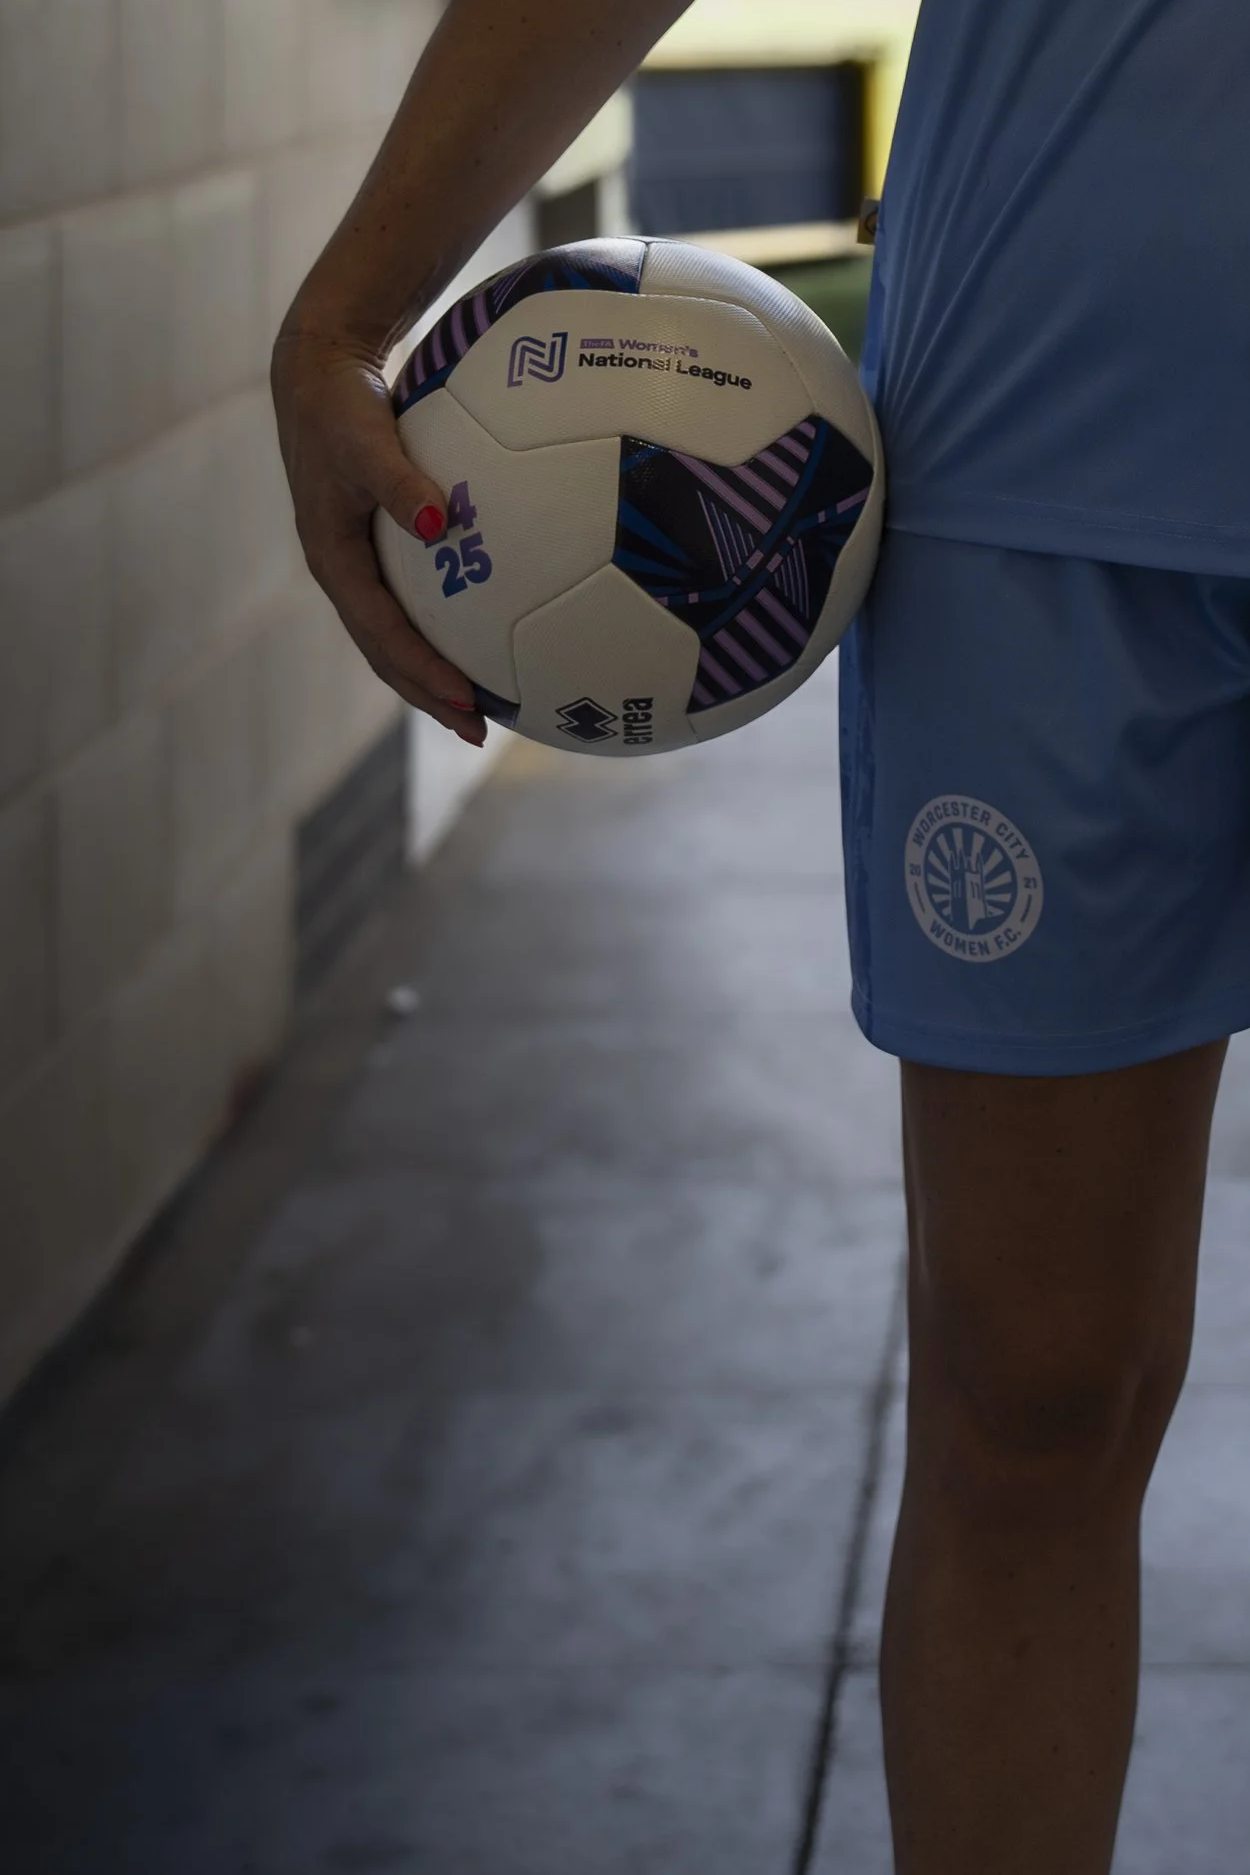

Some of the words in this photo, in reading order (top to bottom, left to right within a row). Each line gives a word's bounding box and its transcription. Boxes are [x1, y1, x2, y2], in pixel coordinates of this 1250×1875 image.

[619, 338, 699, 358] Women's
[578, 352, 671, 372] National
[675, 359, 752, 390] League
[435, 531, 492, 598] 25
[912, 801, 992, 848] WORCESTER
[995, 822, 1030, 860] CITY
[1023, 877, 1038, 889] 21
[929, 918, 991, 957] WOMEN
[994, 927, 1022, 951] F.C.
